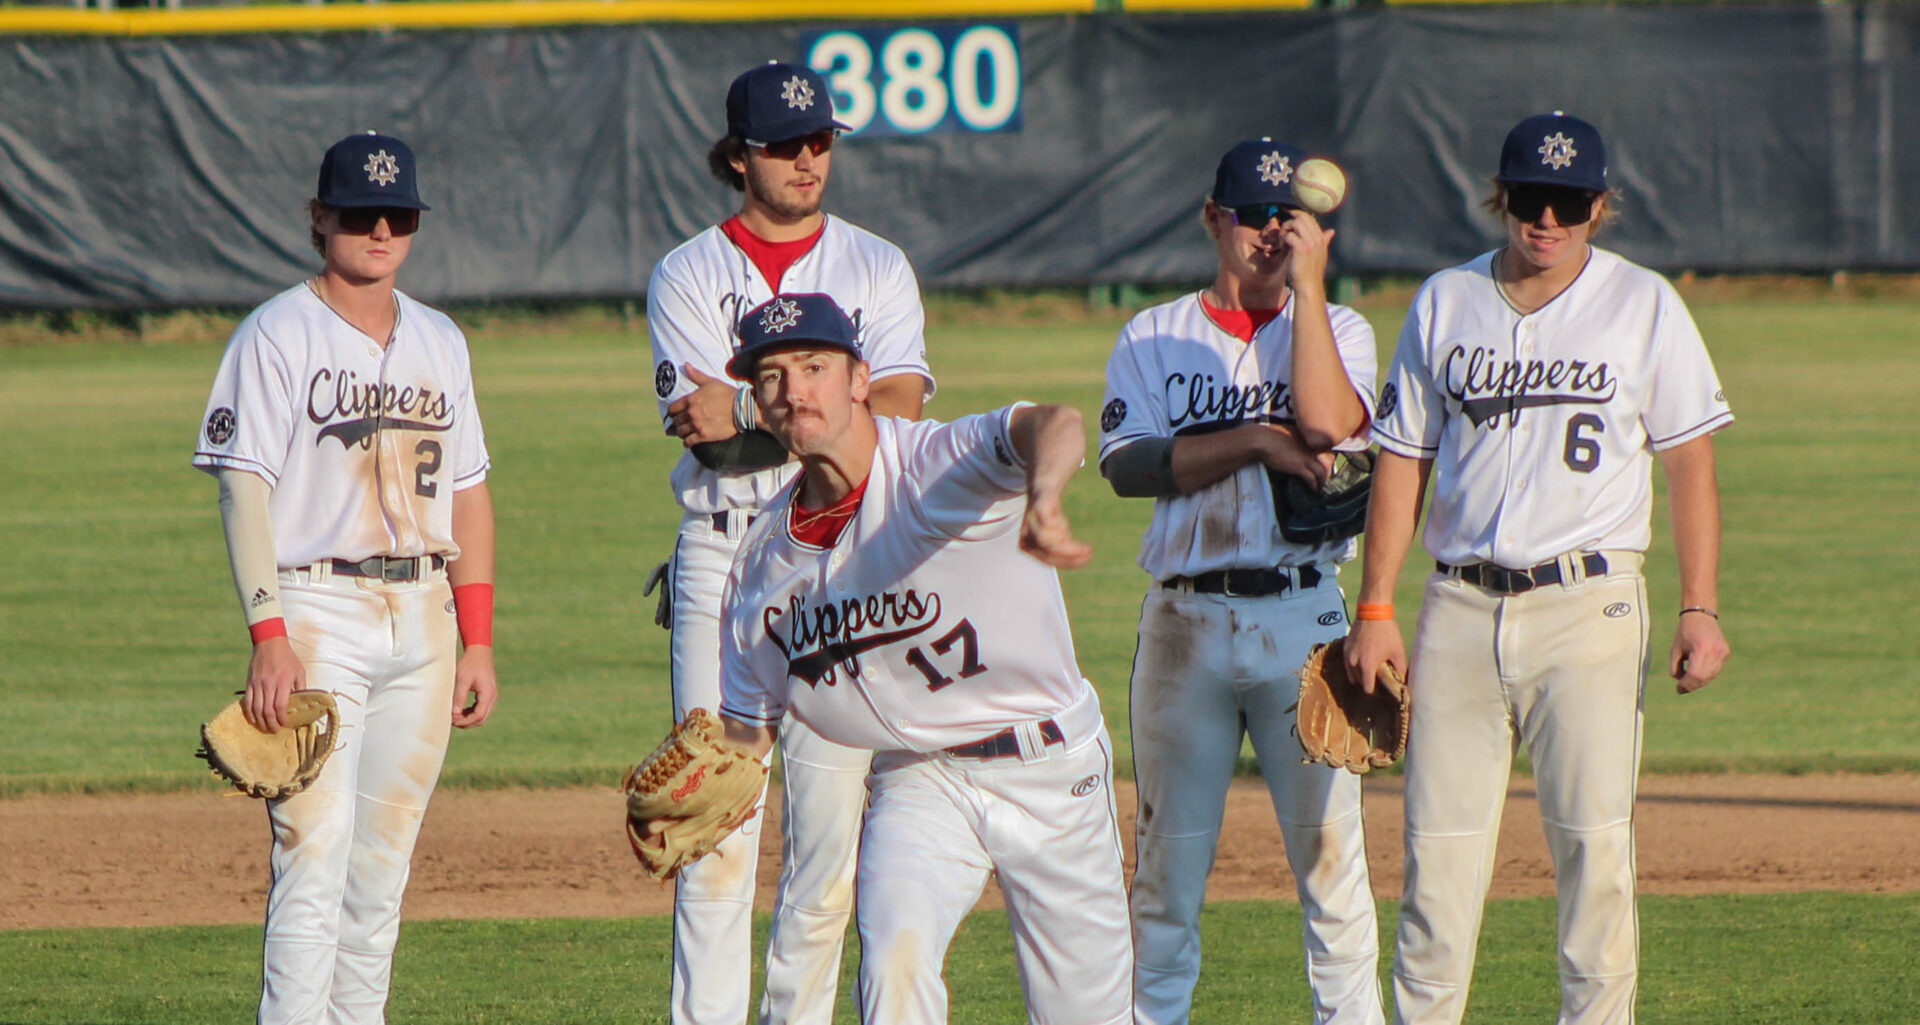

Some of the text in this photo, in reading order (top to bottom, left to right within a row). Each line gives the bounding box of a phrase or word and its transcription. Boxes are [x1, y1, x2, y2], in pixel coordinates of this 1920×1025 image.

[807, 25, 1021, 135] 380
[307, 367, 455, 450] Clippers
[1446, 344, 1617, 430] Clippers
[414, 438, 443, 499] 2
[1563, 412, 1605, 474] 6
[763, 588, 941, 690] Clippers
[905, 617, 987, 693] 17
